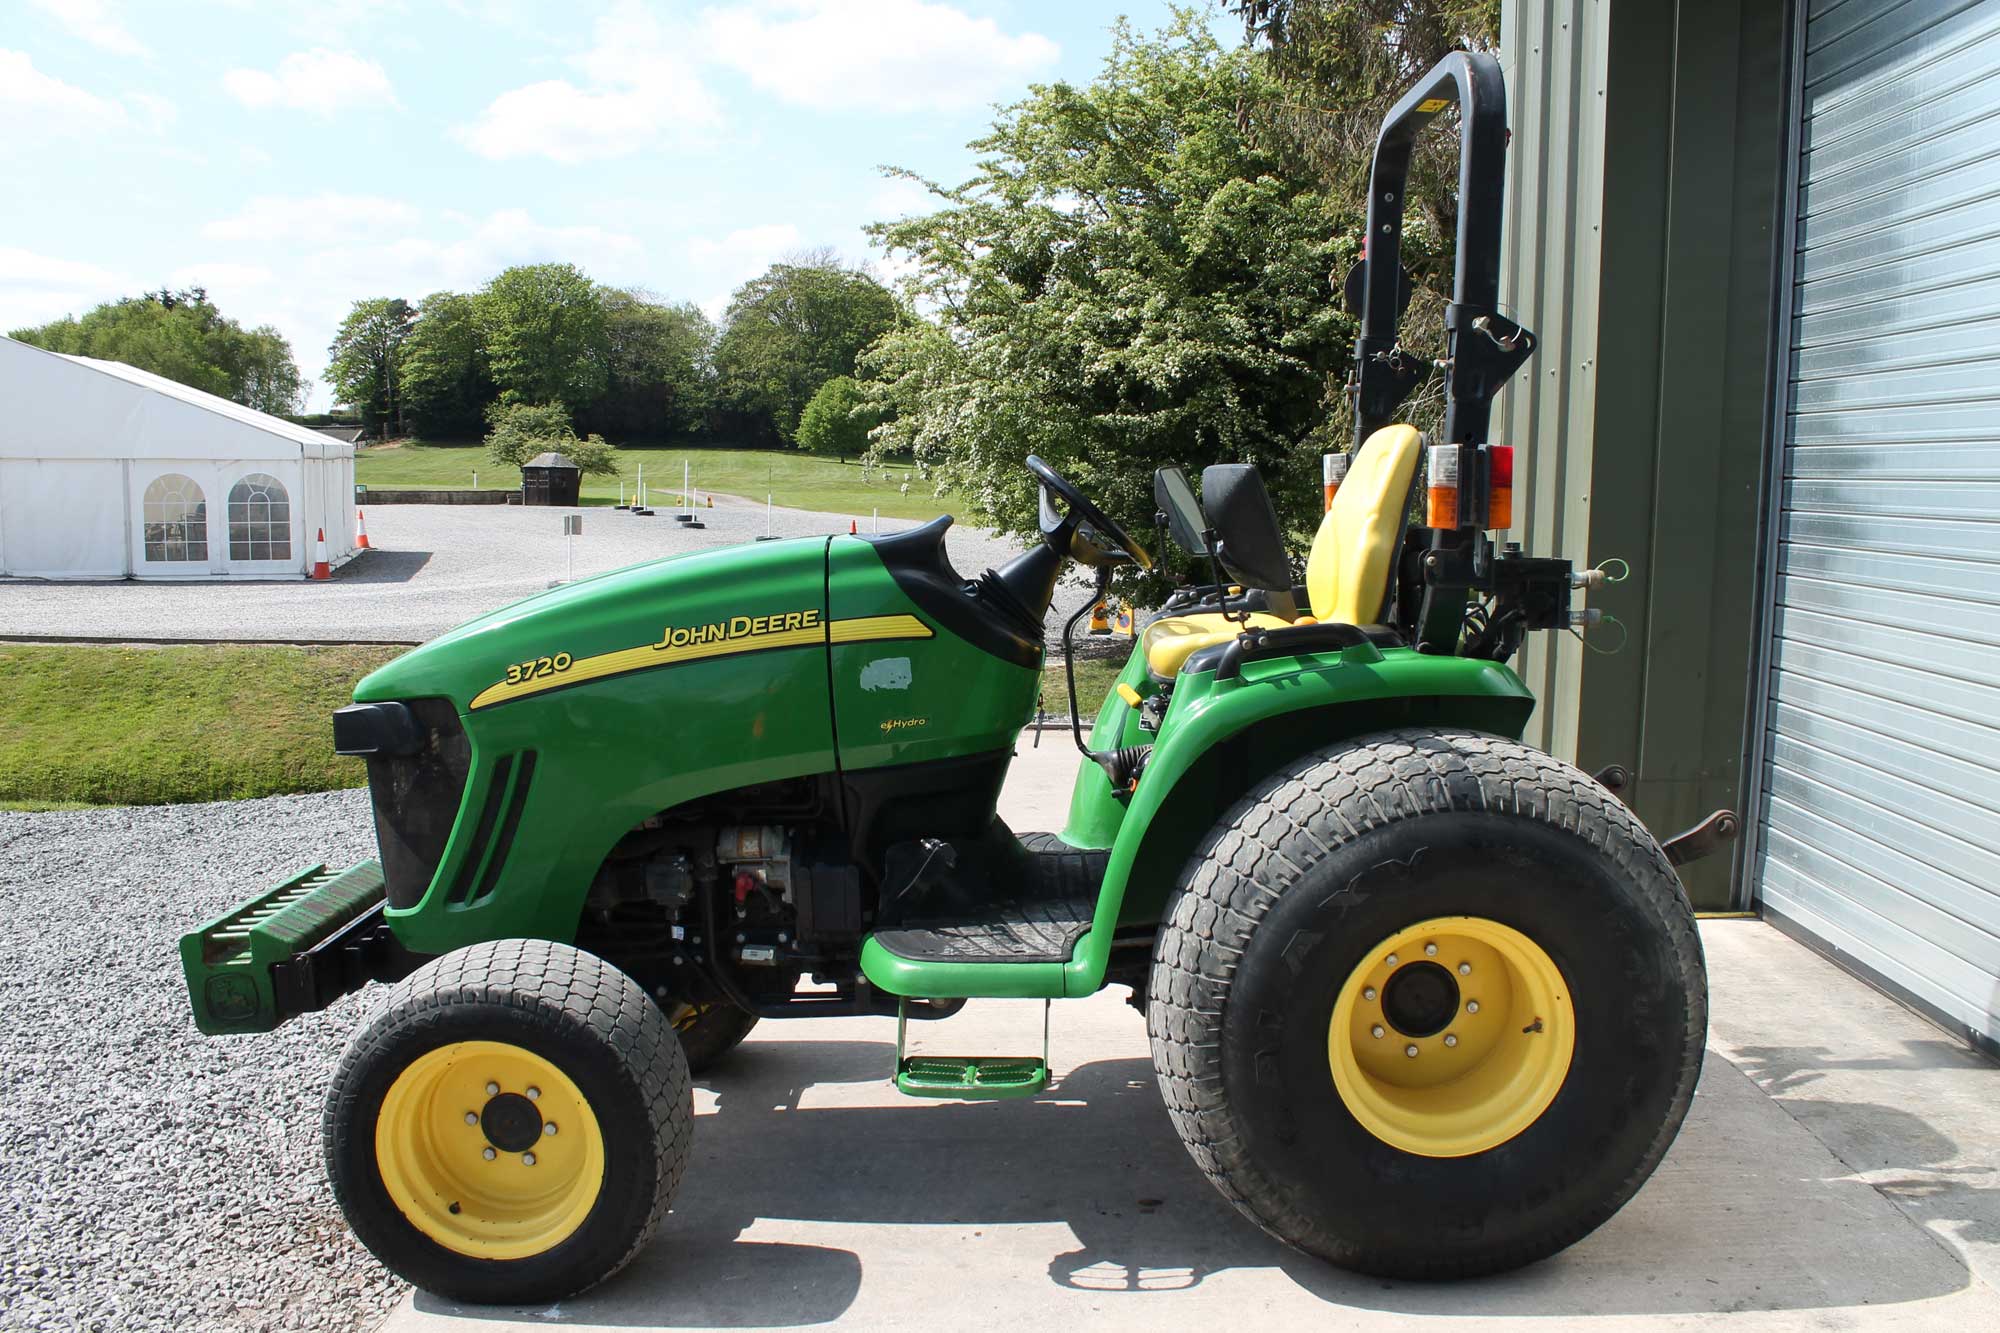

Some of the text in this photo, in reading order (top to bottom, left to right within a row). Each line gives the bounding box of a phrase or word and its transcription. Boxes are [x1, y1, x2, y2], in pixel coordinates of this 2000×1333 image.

[653, 609, 820, 650] JOHN DEERE
[506, 652, 572, 684] 3720
